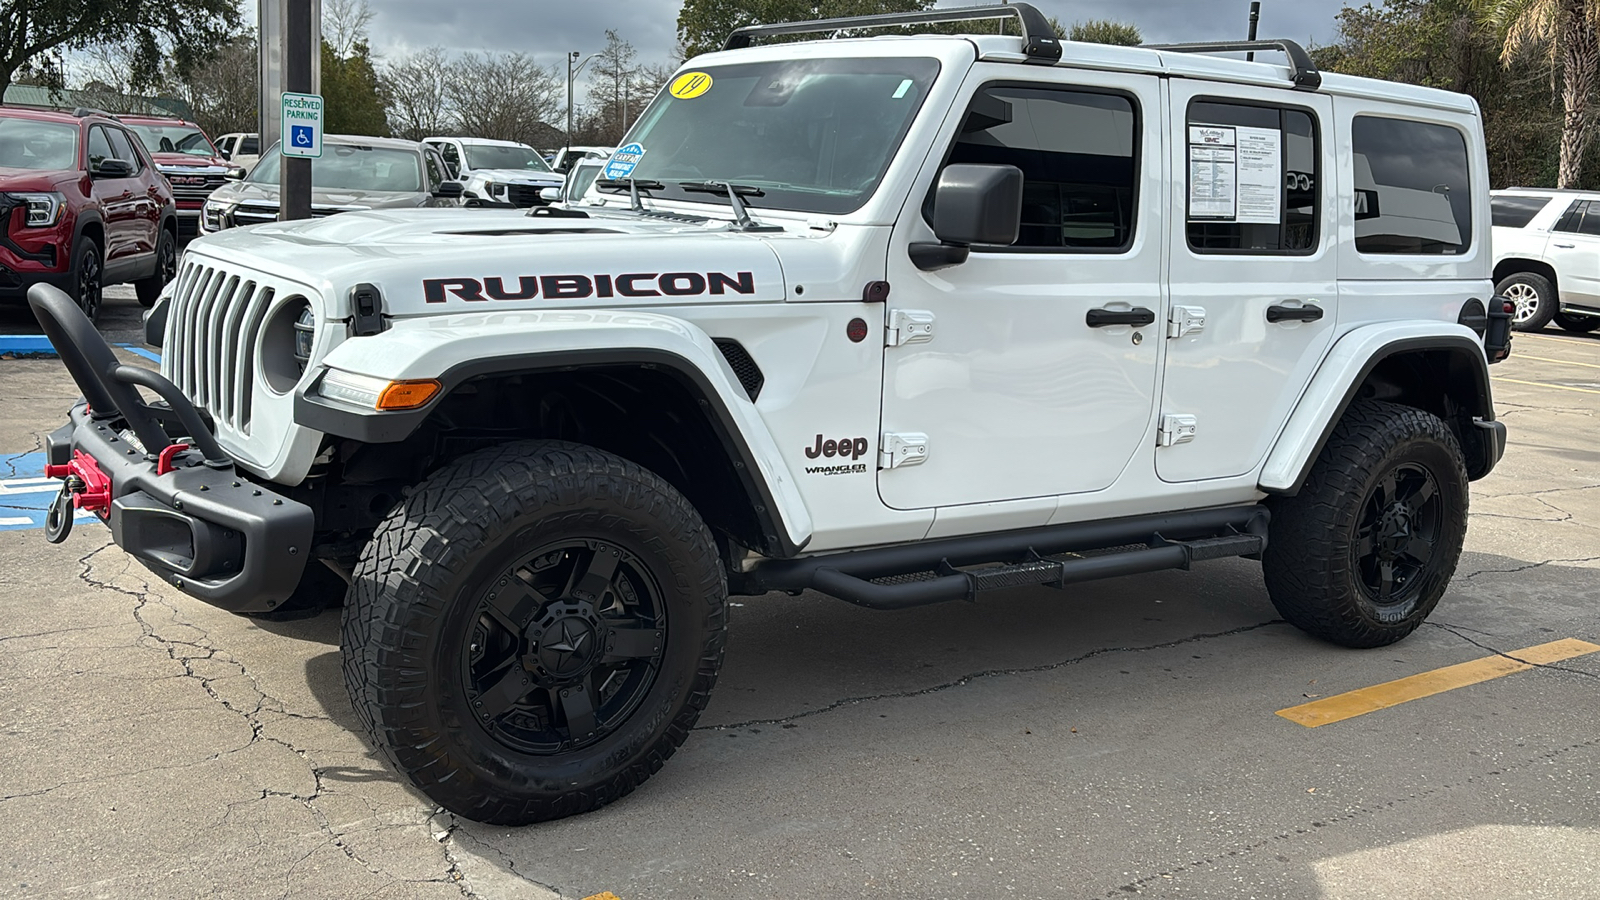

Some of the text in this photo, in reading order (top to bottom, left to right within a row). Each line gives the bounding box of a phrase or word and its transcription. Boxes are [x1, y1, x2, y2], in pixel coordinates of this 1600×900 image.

[675, 75, 707, 95] 19
[284, 99, 320, 109] RESERVED
[286, 110, 319, 120] PARKING
[169, 176, 205, 184] GMC
[423, 272, 755, 303] RUBICON
[805, 434, 868, 461] Jeep
[805, 463, 867, 474] WRANGLER
